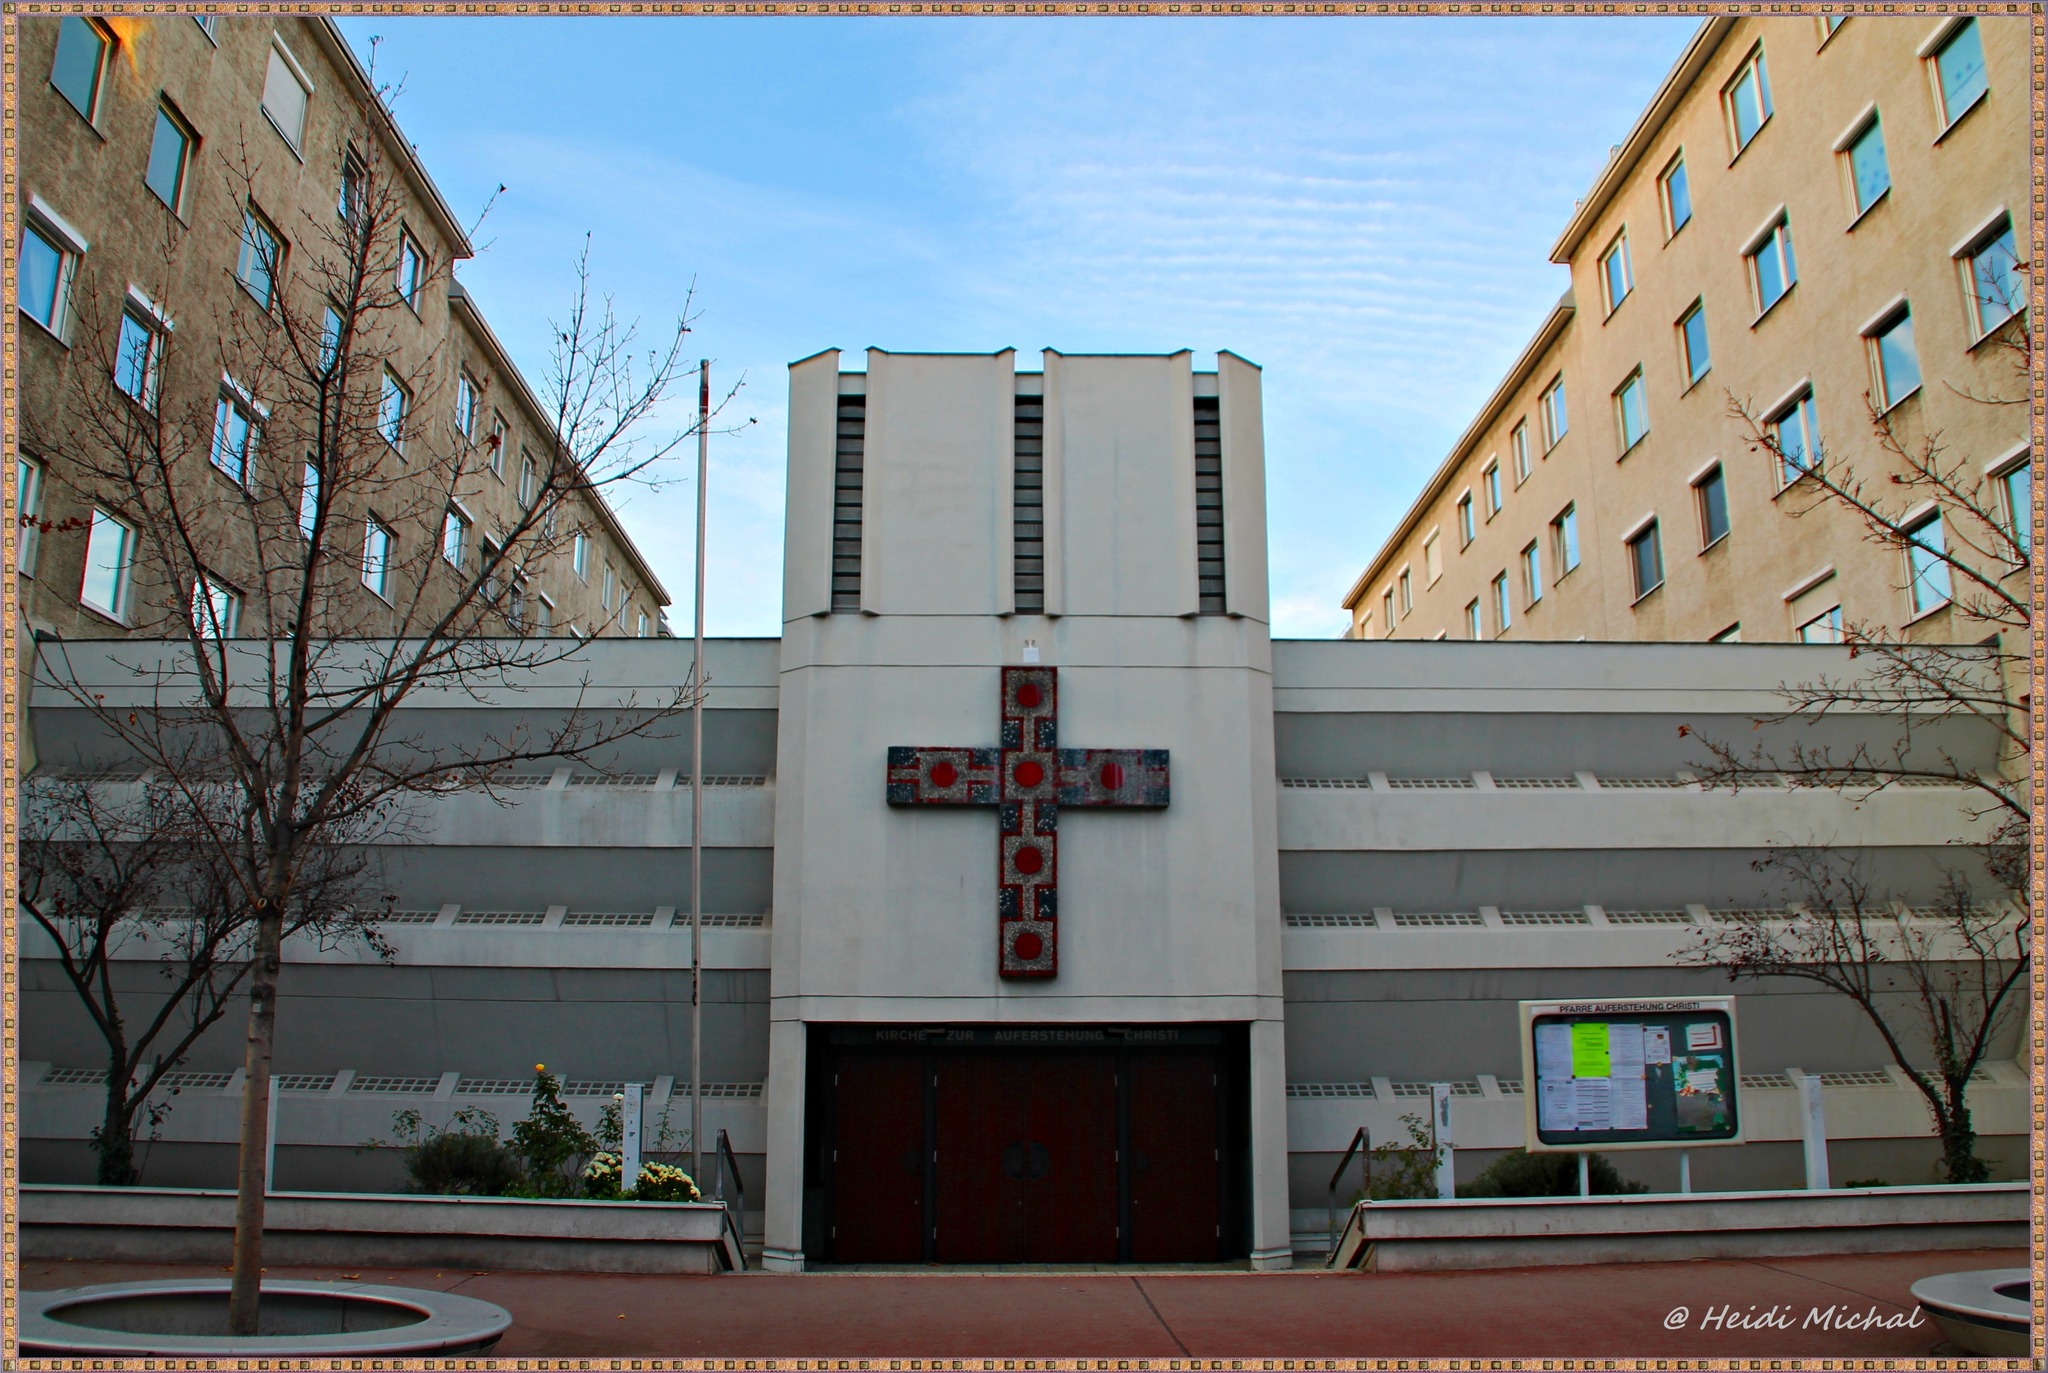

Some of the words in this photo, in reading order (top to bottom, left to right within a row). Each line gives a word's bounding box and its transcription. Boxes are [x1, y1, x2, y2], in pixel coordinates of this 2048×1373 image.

[1559, 1005, 1593, 1013] PFARRE
[1595, 1003, 1664, 1012] AUFERSTEHUNG
[1666, 1002, 1700, 1010] CHRISTI
[875, 1030, 927, 1041] KIRCHE
[946, 1030, 974, 1041] ZUR
[994, 1030, 1104, 1041] AUFERSTEHUNG
[1124, 1029, 1178, 1041] CHRISTI
